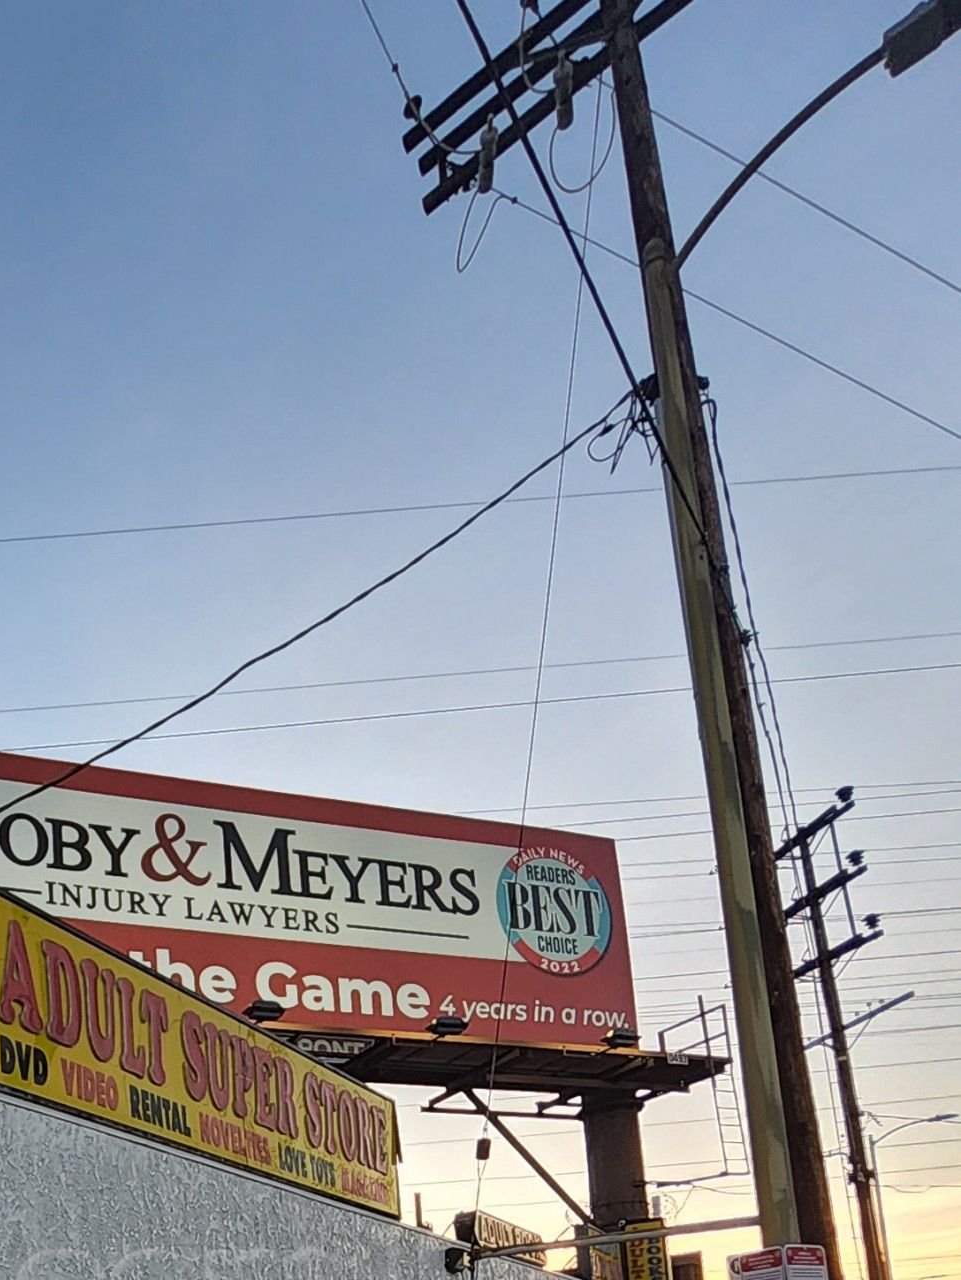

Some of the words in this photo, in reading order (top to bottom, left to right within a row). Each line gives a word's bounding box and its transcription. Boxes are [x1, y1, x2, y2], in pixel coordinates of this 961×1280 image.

[212, 819, 481, 917] MEYERS
[526, 864, 576, 886] READERS
[549, 848, 586, 875] NEWS
[45, 881, 172, 917] INJURY
[184, 896, 340, 934] LAWYERS
[504, 880, 601, 938] BEST
[537, 935, 579, 956] CHOICE
[540, 959, 580, 974] 2022
[255, 960, 431, 1019] Game
[439, 995, 456, 1017] 4
[462, 1000, 528, 1023] years
[534, 999, 554, 1023] in
[561, 1007, 576, 1024] a
[583, 1009, 630, 1029] row.
[0, 1034, 49, 1086] DVD
[60, 1058, 119, 1112] VIDEO
[129, 1084, 191, 1138] RENTAL
[278, 1142, 308, 1179] LOVE
[309, 1156, 336, 1188] TOYS
[181, 1009, 299, 1140] SUPER
[304, 1072, 388, 1176] STORE
